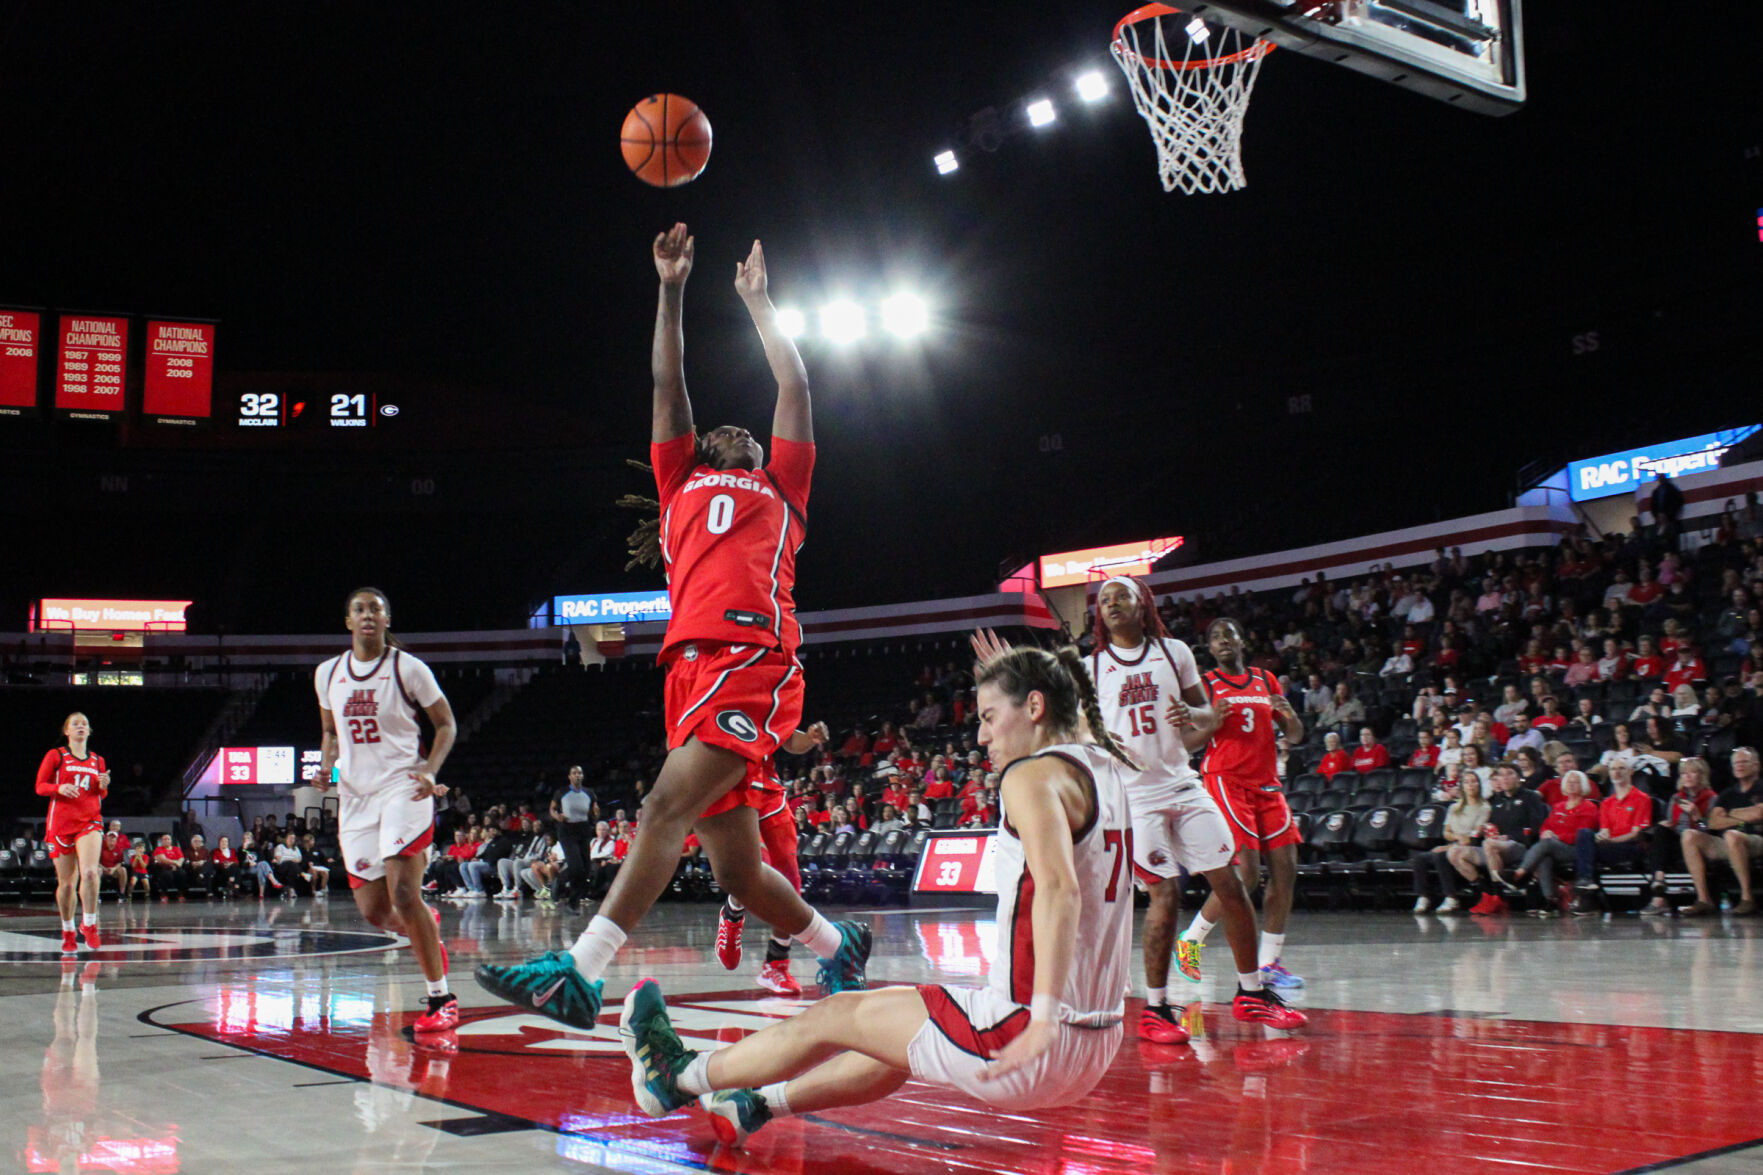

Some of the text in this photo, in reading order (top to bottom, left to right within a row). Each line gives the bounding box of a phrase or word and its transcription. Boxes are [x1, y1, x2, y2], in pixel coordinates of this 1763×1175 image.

[71, 320, 117, 334] NATIONAL
[159, 326, 204, 340] NATIONAL
[66, 333, 121, 347] CHAMPIONS
[153, 339, 208, 353] CHAMPIONS
[5, 347, 33, 357] 2008
[64, 350, 122, 361] 1987 1999
[94, 363, 121, 373] 2005
[166, 358, 193, 367] 2008
[63, 373, 120, 384] 1993 2006
[166, 369, 193, 378] 2009
[62, 384, 120, 395] 1998 2007
[240, 393, 278, 416] 32
[330, 394, 366, 416] 21
[238, 418, 278, 426] MCCLAIN
[330, 419, 366, 427] WILKINS
[1580, 461, 1629, 489] RAC
[682, 473, 775, 499] GEORGIA
[707, 494, 735, 534] 0
[562, 600, 598, 617] RAC
[1119, 684, 1159, 707] STATE
[1128, 704, 1158, 736] 15
[1241, 707, 1255, 732] 3
[348, 719, 382, 744] 22
[230, 766, 250, 780] 33
[74, 774, 91, 791] 14
[936, 861, 962, 886] 33
